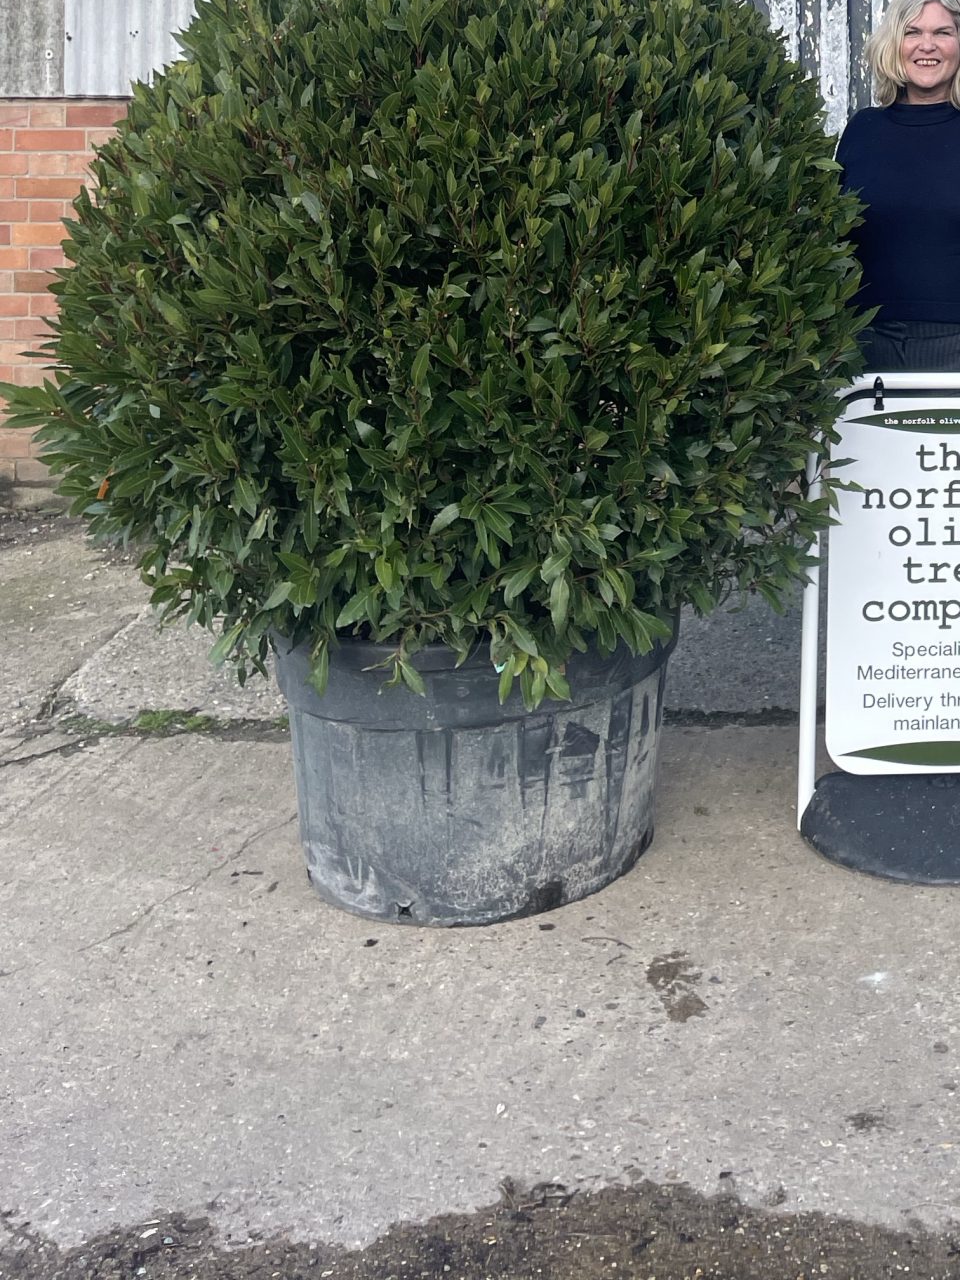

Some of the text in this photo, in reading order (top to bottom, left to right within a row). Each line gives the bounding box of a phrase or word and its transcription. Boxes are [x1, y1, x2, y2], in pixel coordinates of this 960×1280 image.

[884, 417, 899, 425] the
[902, 417, 936, 425] norfolk
[863, 693, 933, 712] Delivery
